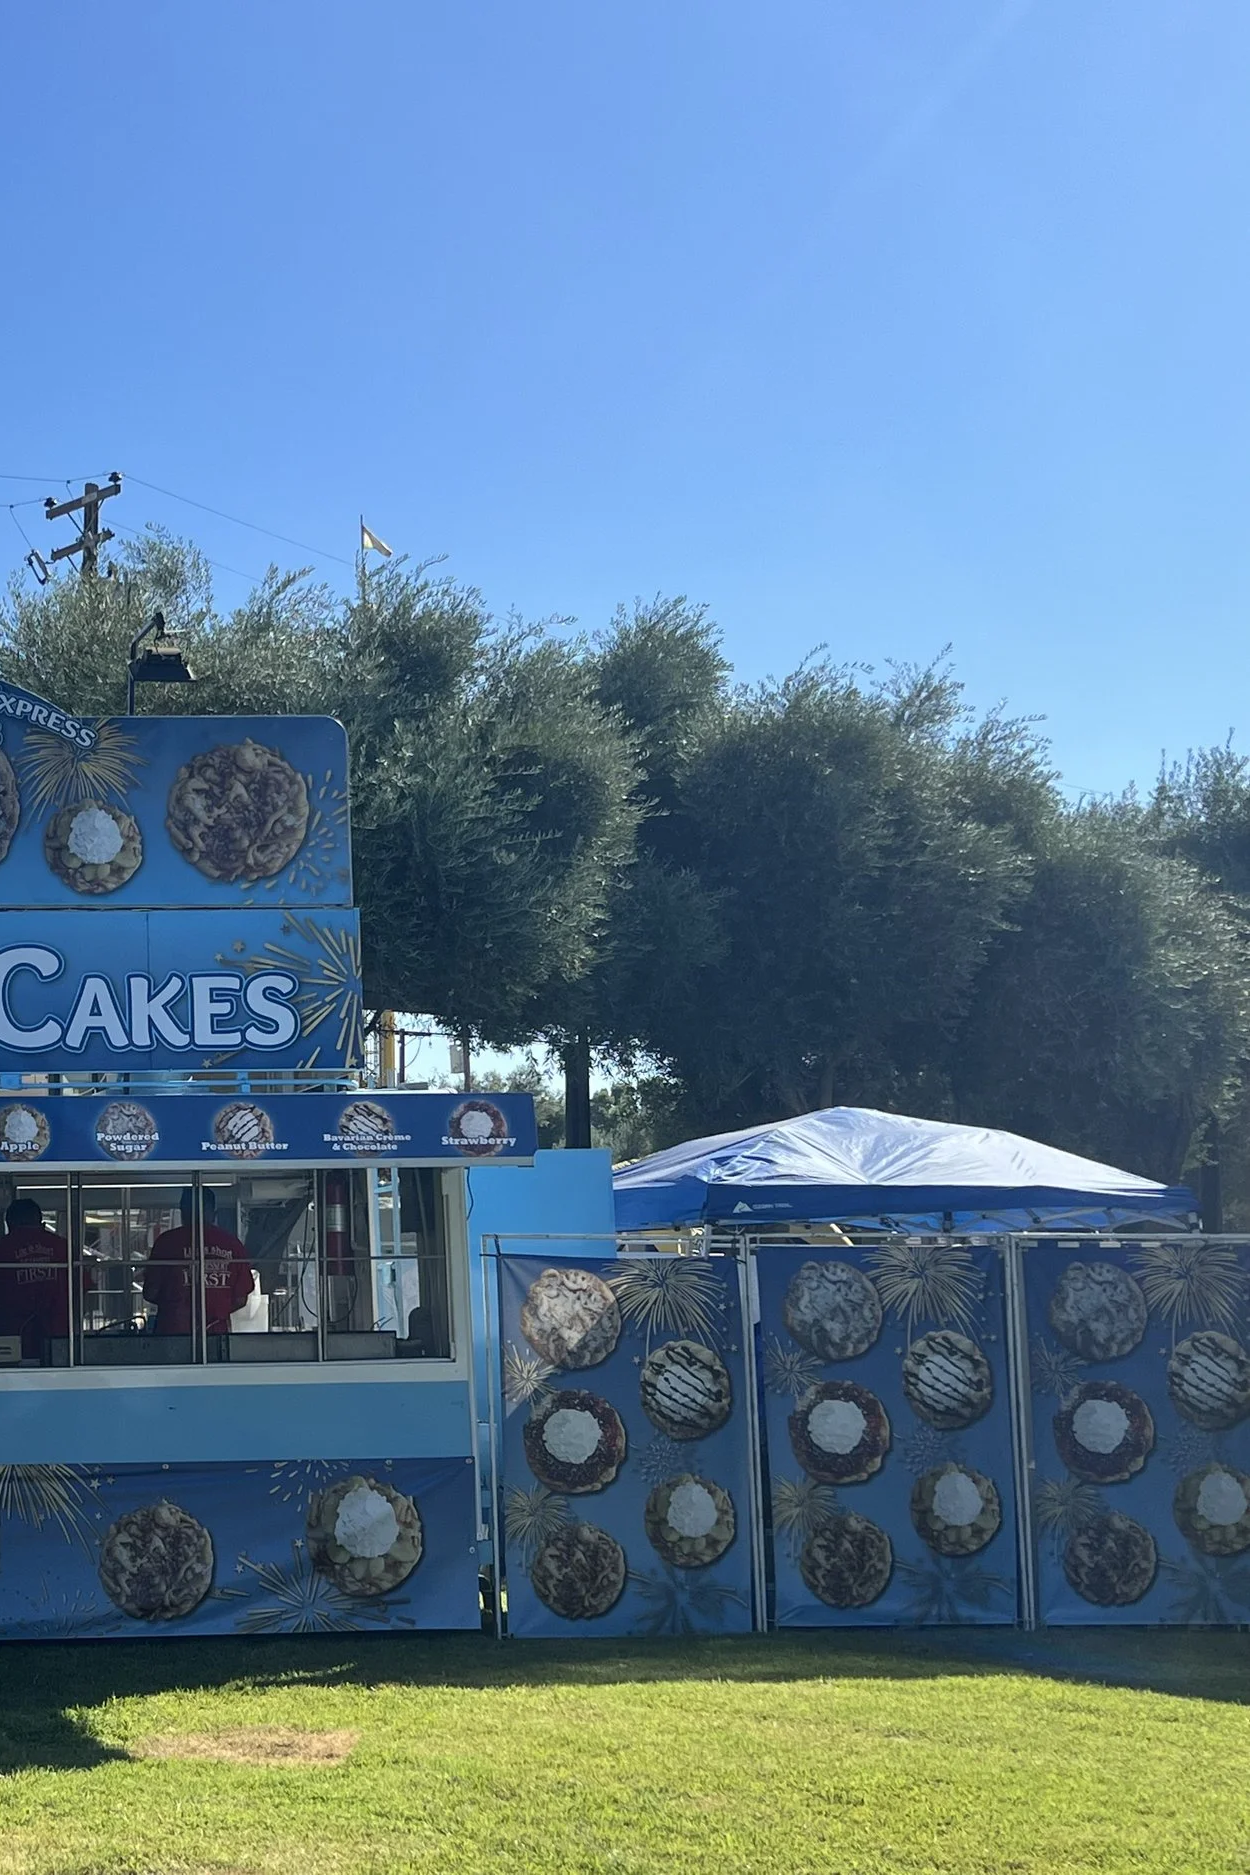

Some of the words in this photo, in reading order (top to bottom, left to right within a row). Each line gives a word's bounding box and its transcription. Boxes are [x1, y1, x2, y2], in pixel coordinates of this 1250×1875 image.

[97, 1132, 159, 1142] Powdered
[323, 1133, 373, 1142] Bavarian
[441, 1136, 517, 1147] Strawberry
[0, 1141, 40, 1151] Apple
[110, 1143, 148, 1152] Sugar
[202, 1142, 246, 1151] Peanut
[249, 1141, 288, 1151] Butter
[344, 1143, 398, 1151] Chocolate
